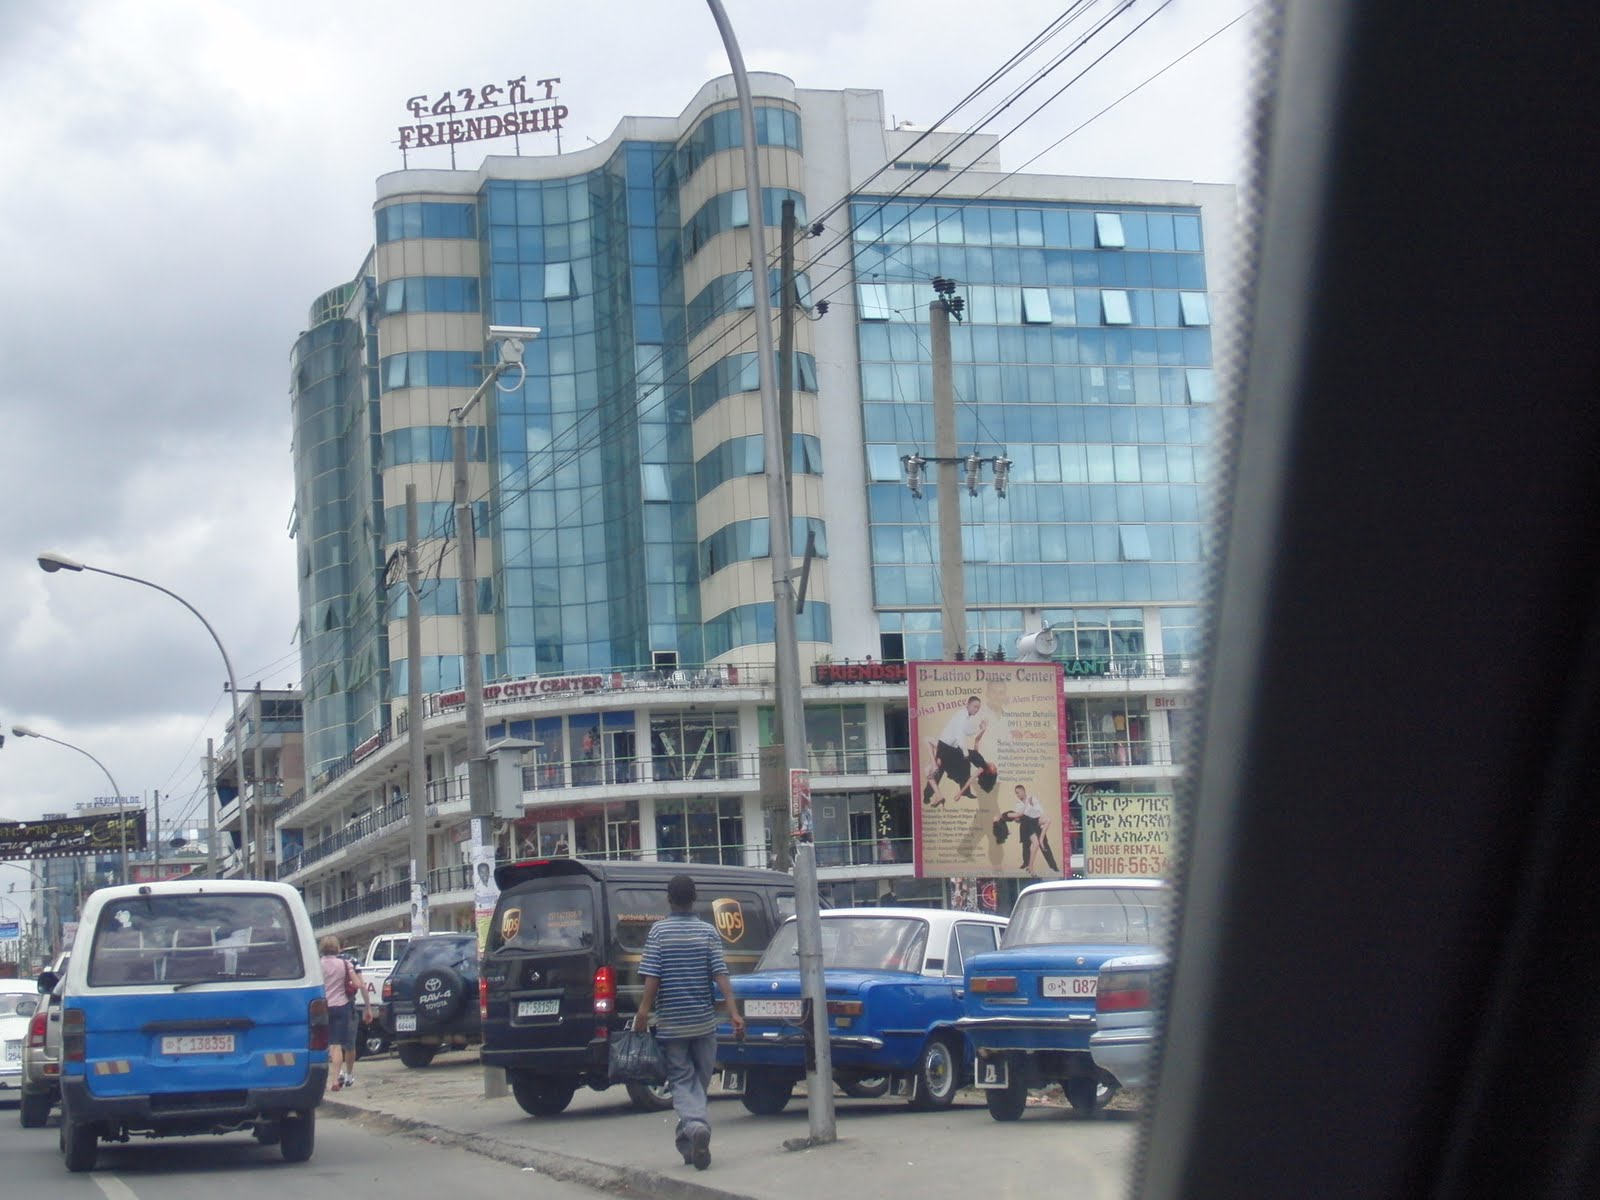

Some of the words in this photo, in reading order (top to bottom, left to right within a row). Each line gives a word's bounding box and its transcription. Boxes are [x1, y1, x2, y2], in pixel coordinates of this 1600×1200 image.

[398, 105, 569, 149] FRIENDSHIP
[818, 664, 907, 680] FRIENDSH
[1063, 660, 1108, 673] RANT
[919, 668, 971, 682] B-Latino
[975, 668, 1012, 682] Dance
[1016, 668, 1054, 682] Center
[503, 681, 538, 697] CITY
[540, 675, 603, 692] CENTER
[918, 687, 944, 698] Learn
[937, 698, 967, 712] Dance
[1092, 844, 1120, 855] HOUSE
[1123, 844, 1164, 855] RENTAL
[501, 918, 520, 936] ups
[715, 911, 743, 936] ups
[1072, 979, 1097, 993] 087
[419, 990, 451, 1003] RAV-4
[425, 1000, 448, 1010] TOYOTA
